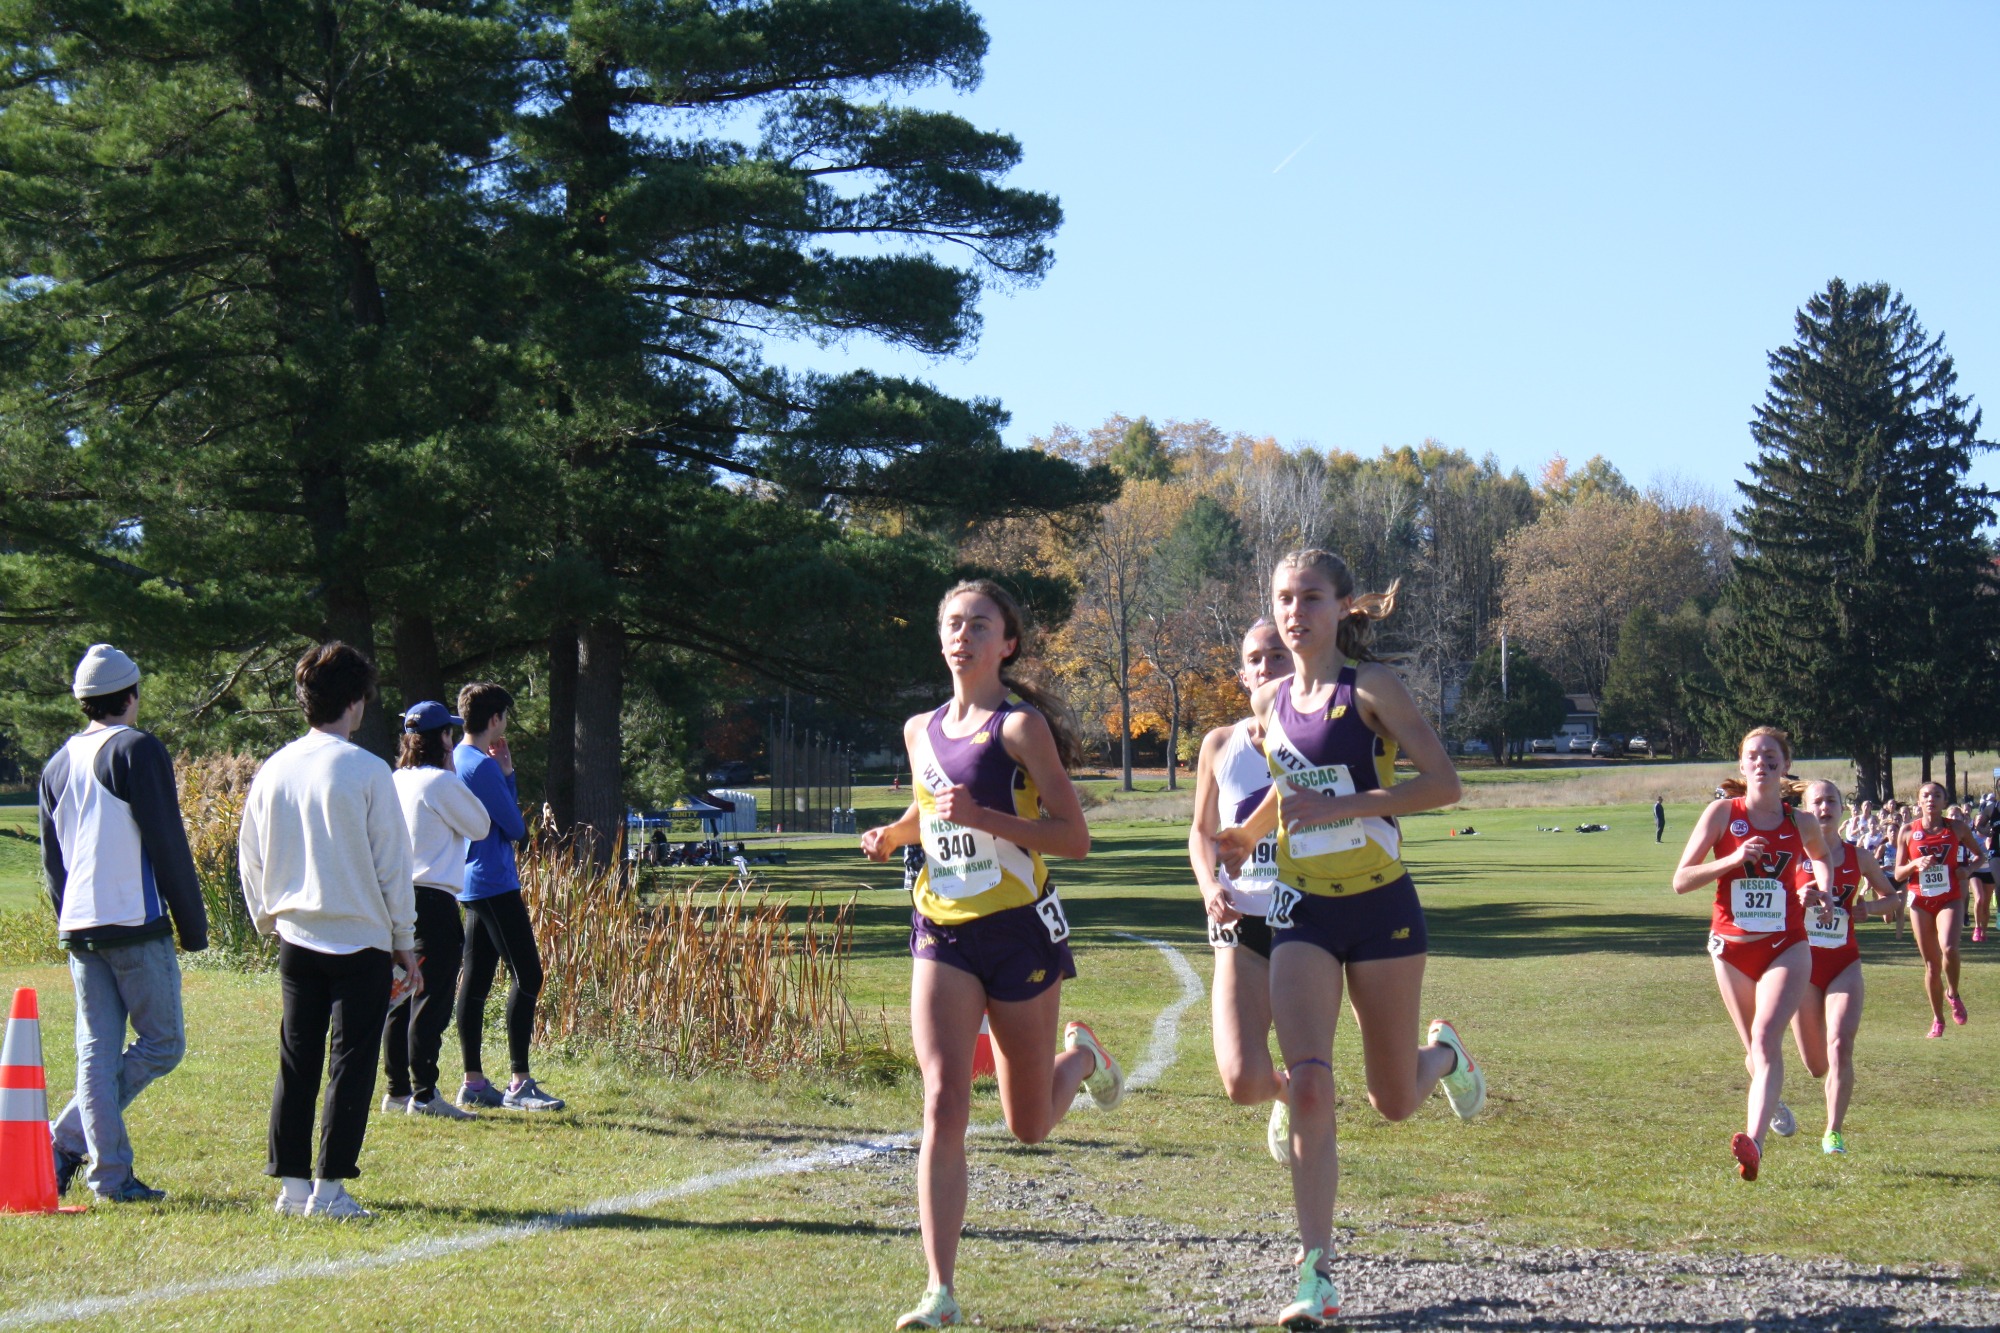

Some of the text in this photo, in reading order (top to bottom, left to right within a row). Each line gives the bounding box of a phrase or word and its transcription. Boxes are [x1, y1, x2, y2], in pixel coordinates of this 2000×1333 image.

[923, 763, 947, 790] WI
[938, 833, 976, 861] 340
[933, 859, 993, 878] CHAMPIONSHIP
[1925, 873, 1943, 883] 330
[1740, 880, 1777, 891] NESCAC
[1745, 892, 1773, 908] 327
[1735, 911, 1782, 919] CHAMPIONSHIP
[1806, 930, 1845, 939] CHAMPIONSHIP
